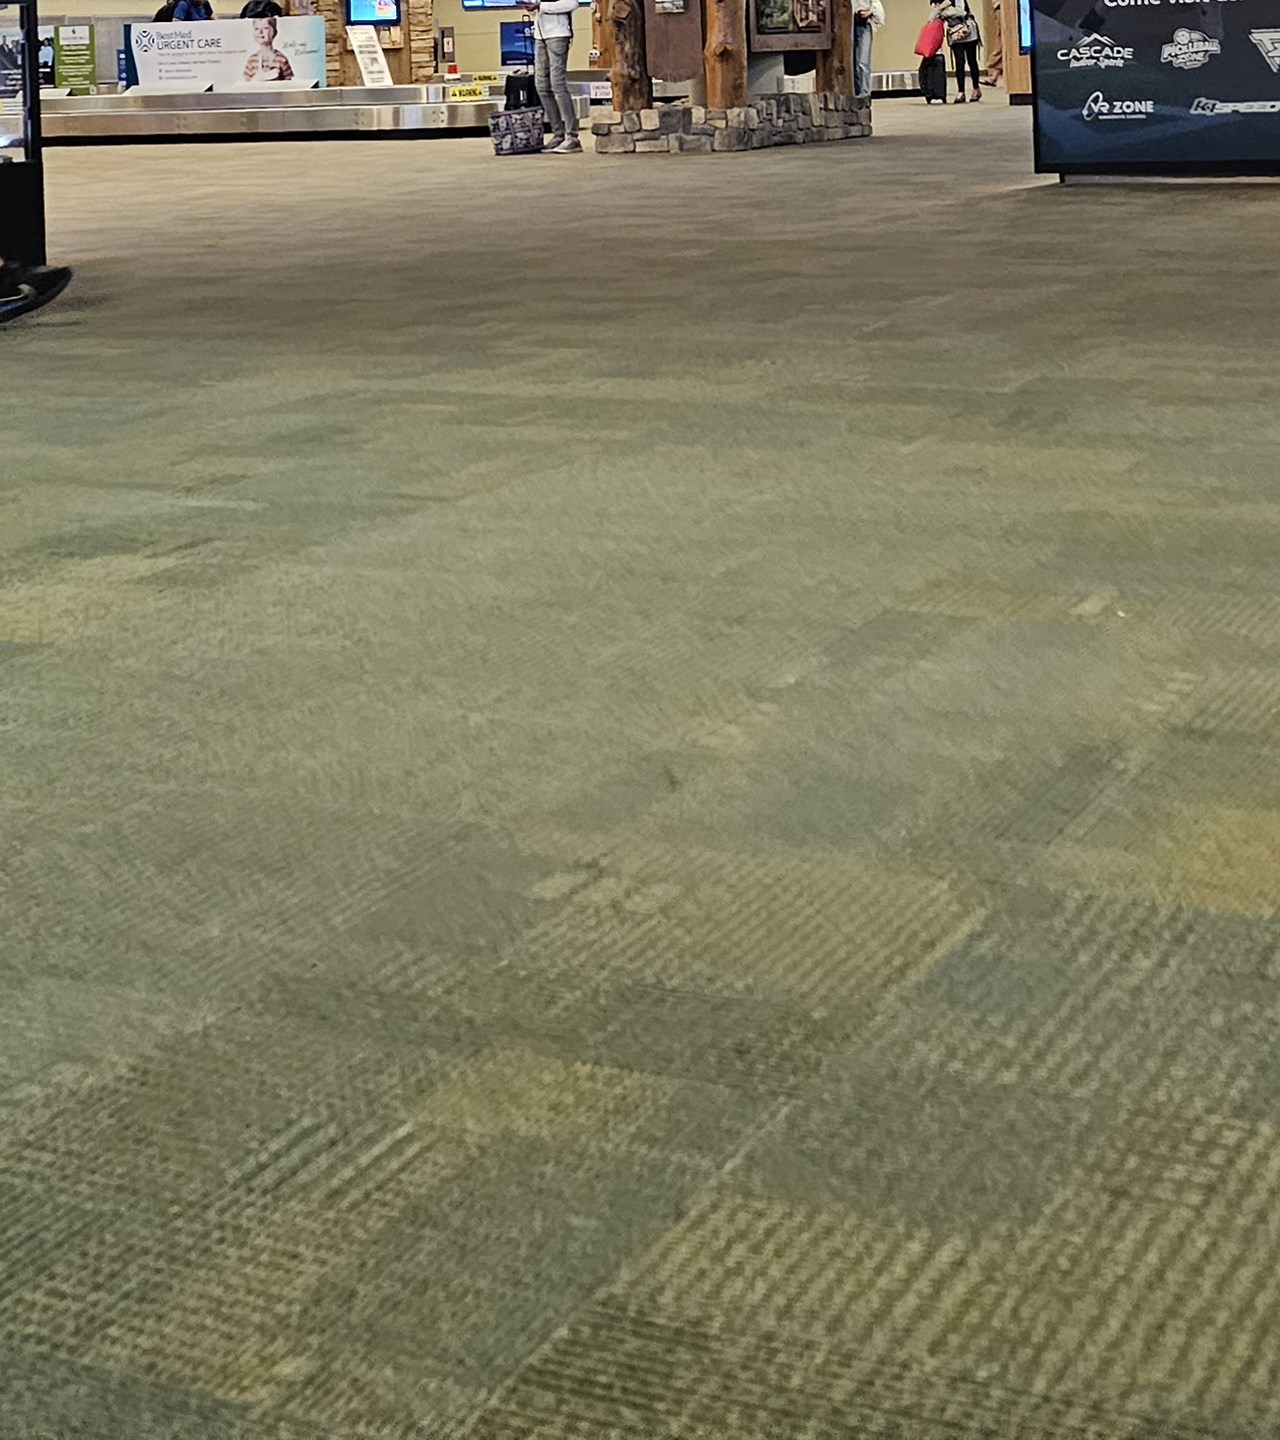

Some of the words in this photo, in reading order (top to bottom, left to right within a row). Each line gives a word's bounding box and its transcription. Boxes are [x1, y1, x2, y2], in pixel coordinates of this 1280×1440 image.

[157, 39, 195, 50] URGENT
[197, 38, 222, 49] CARE
[1056, 46, 1135, 60] CASCADE
[1112, 100, 1154, 113] ZONE
